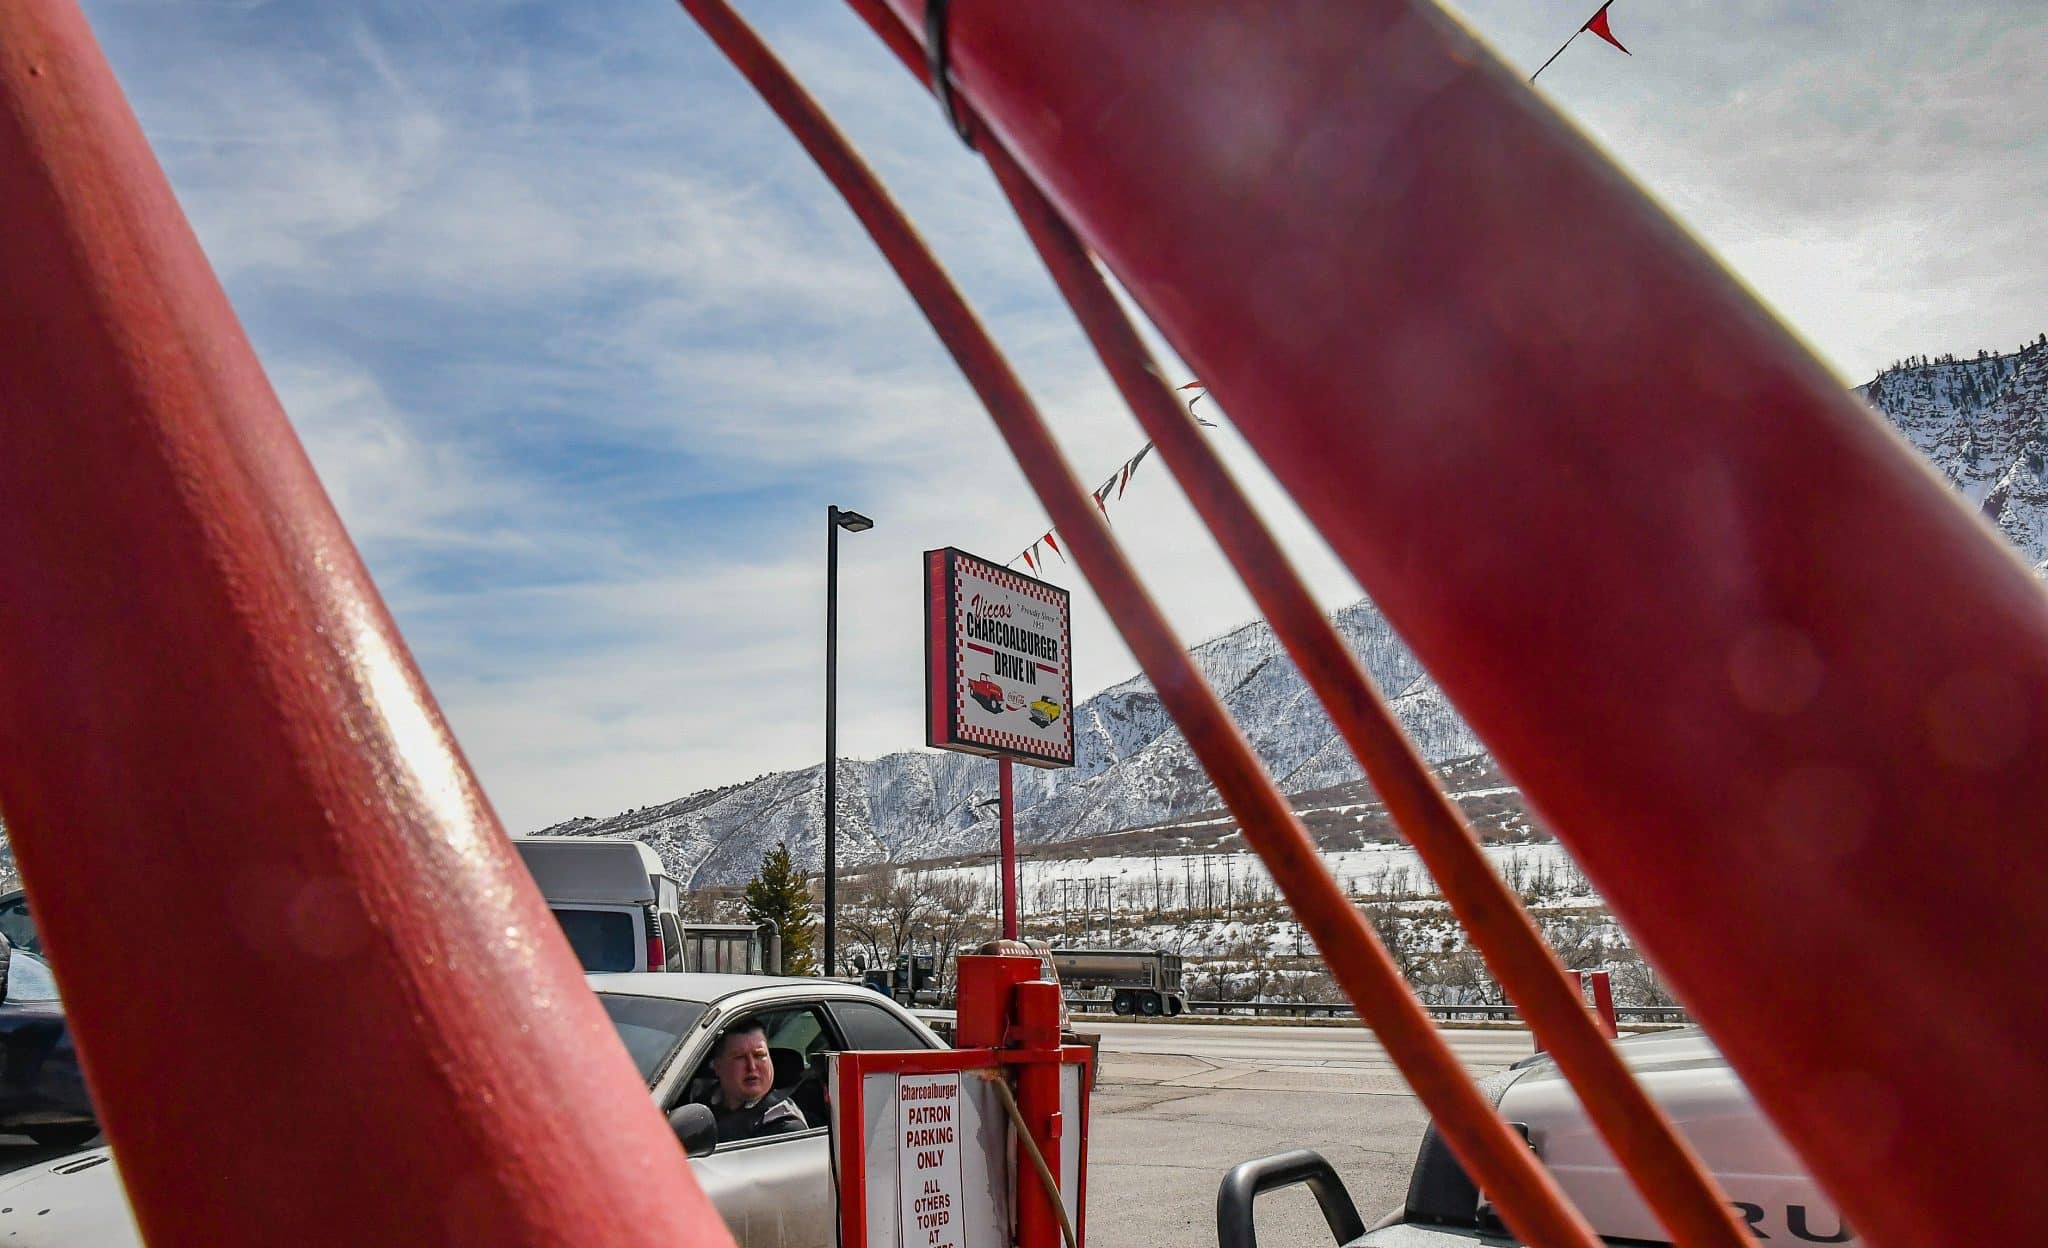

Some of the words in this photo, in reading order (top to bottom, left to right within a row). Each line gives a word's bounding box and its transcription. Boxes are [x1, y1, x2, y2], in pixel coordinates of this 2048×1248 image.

[966, 611, 1058, 663] CHARCOALBURGER
[994, 649, 1024, 682] DRIVE
[1025, 660, 1037, 685] IN
[901, 1083, 957, 1101] Charcoalburger
[909, 1105, 951, 1125] PATRON
[906, 1126, 953, 1148] PARKING
[917, 1149, 944, 1169] ONLY
[924, 1179, 940, 1195] ALL
[914, 1194, 950, 1213] OTHERS
[917, 1211, 949, 1230] TOWED
[929, 1229, 939, 1245] AT
